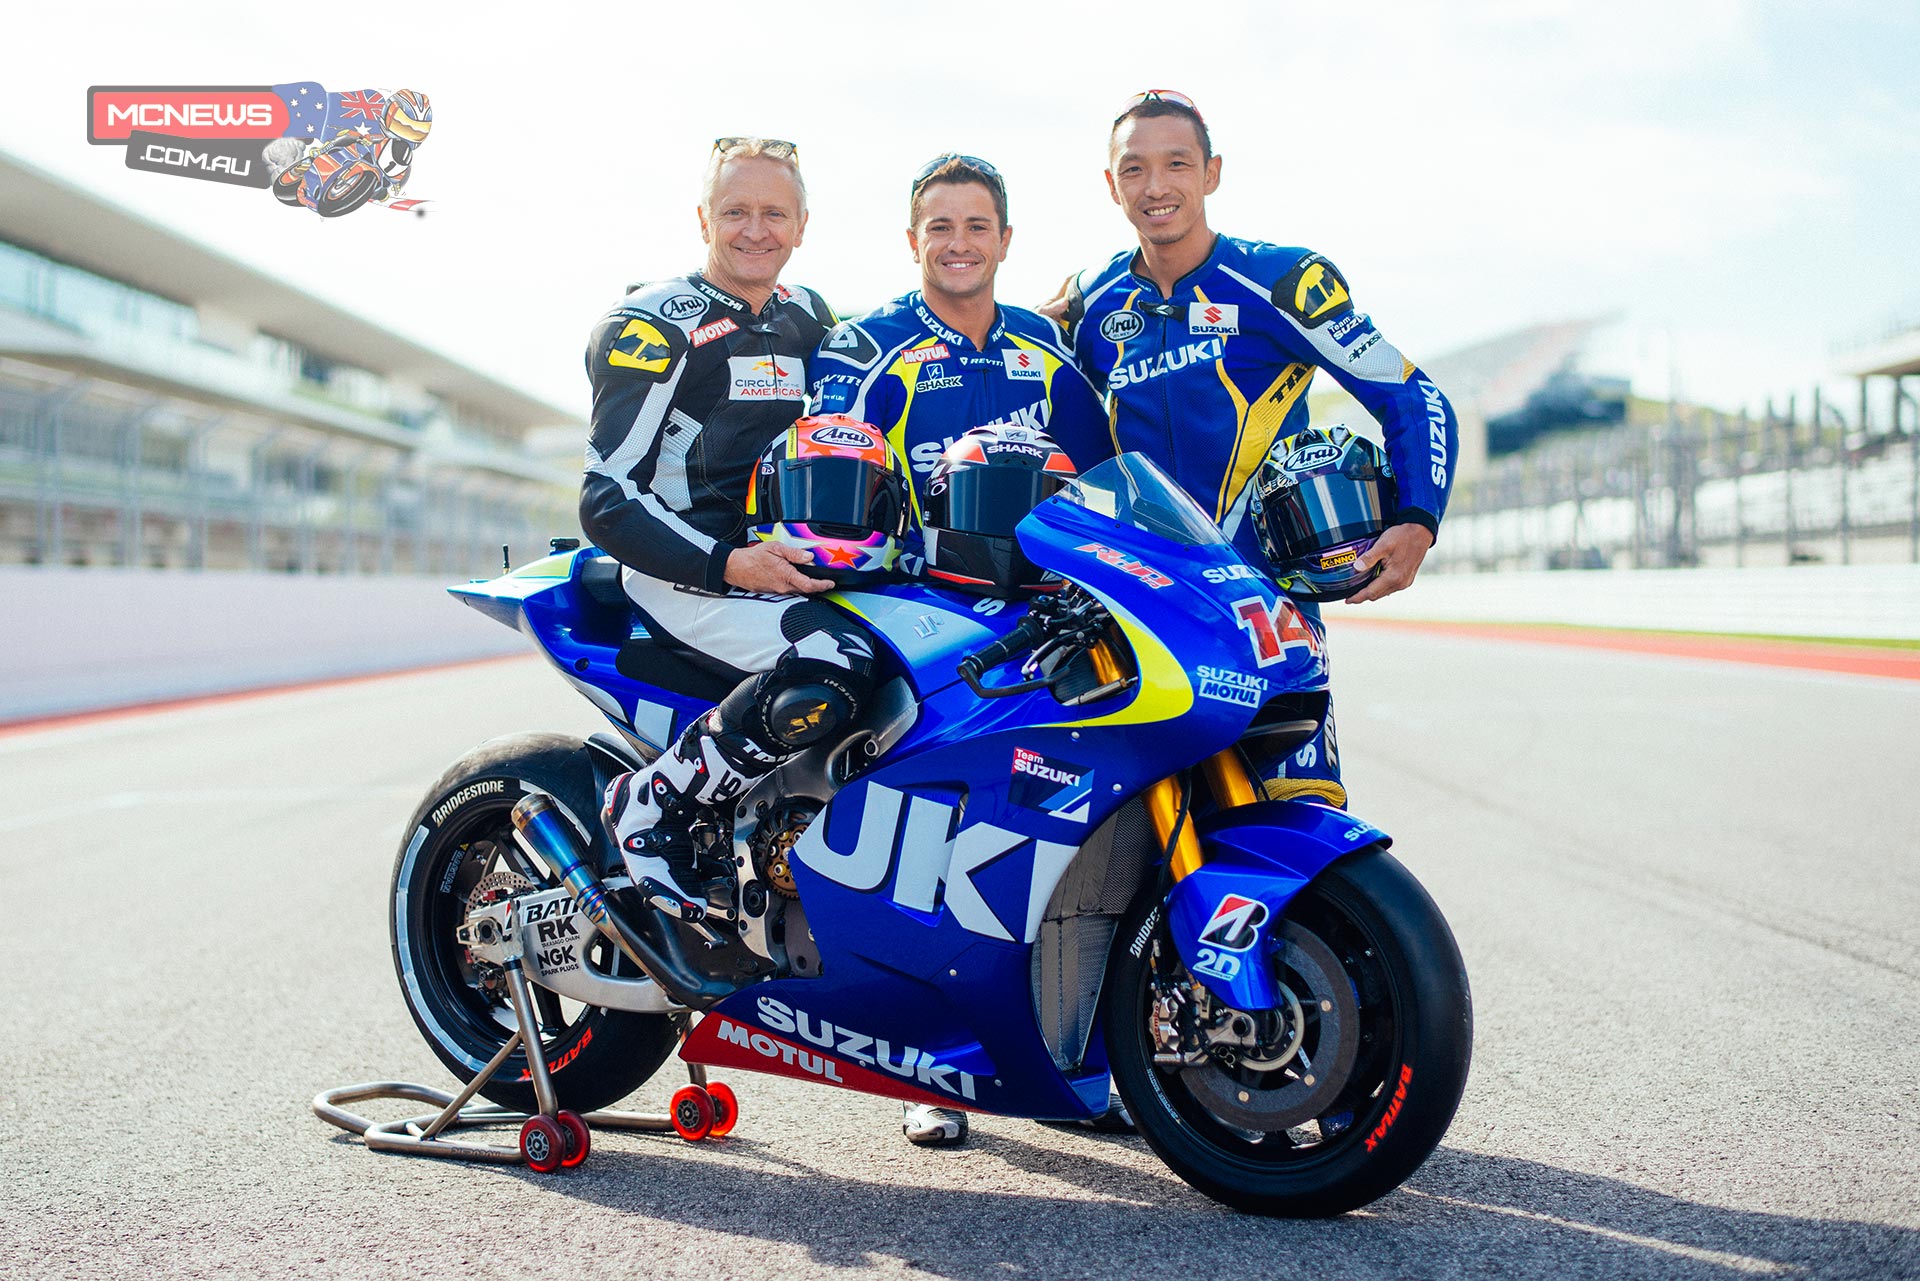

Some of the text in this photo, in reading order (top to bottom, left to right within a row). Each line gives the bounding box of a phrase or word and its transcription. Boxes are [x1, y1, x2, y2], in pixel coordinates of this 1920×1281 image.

[666, 296, 702, 318] Arai
[700, 283, 743, 312] TAICHI
[694, 319, 738, 345] MOTUL
[916, 307, 963, 346] SUZUKI
[1105, 314, 1138, 335] Arai
[1191, 326, 1238, 335] SUZUKI
[1329, 316, 1351, 333] Team
[904, 347, 949, 363] MOTUL
[1108, 338, 1224, 390] SUZUKI
[735, 379, 783, 388] CIRCUT
[916, 375, 963, 392] SHARK
[1011, 370, 1041, 378] SUZUKI
[740, 388, 802, 397] AMERICAS
[816, 428, 866, 443] Arai
[1417, 380, 1447, 488] SUZUKI
[986, 444, 1044, 460] SHARK
[1289, 446, 1336, 468] Arai
[1230, 596, 1322, 669] 14
[1196, 665, 1268, 691] SUZUKI
[1202, 681, 1256, 704] MOTUL
[1016, 748, 1044, 764] Team
[1014, 759, 1081, 787] SUZUKI
[431, 780, 504, 827] BRIDGESTONE
[537, 915, 579, 943] RK
[1129, 906, 1160, 960] BRIDGE
[536, 944, 577, 969] NGK
[1193, 948, 1240, 976] 2D
[541, 963, 579, 977] SPARK PLUGS
[517, 1026, 593, 1082] BATTLX
[717, 1019, 843, 1083] MOTUL
[757, 996, 976, 1100] SUZUKI
[1363, 1063, 1413, 1153] BATTLAX
